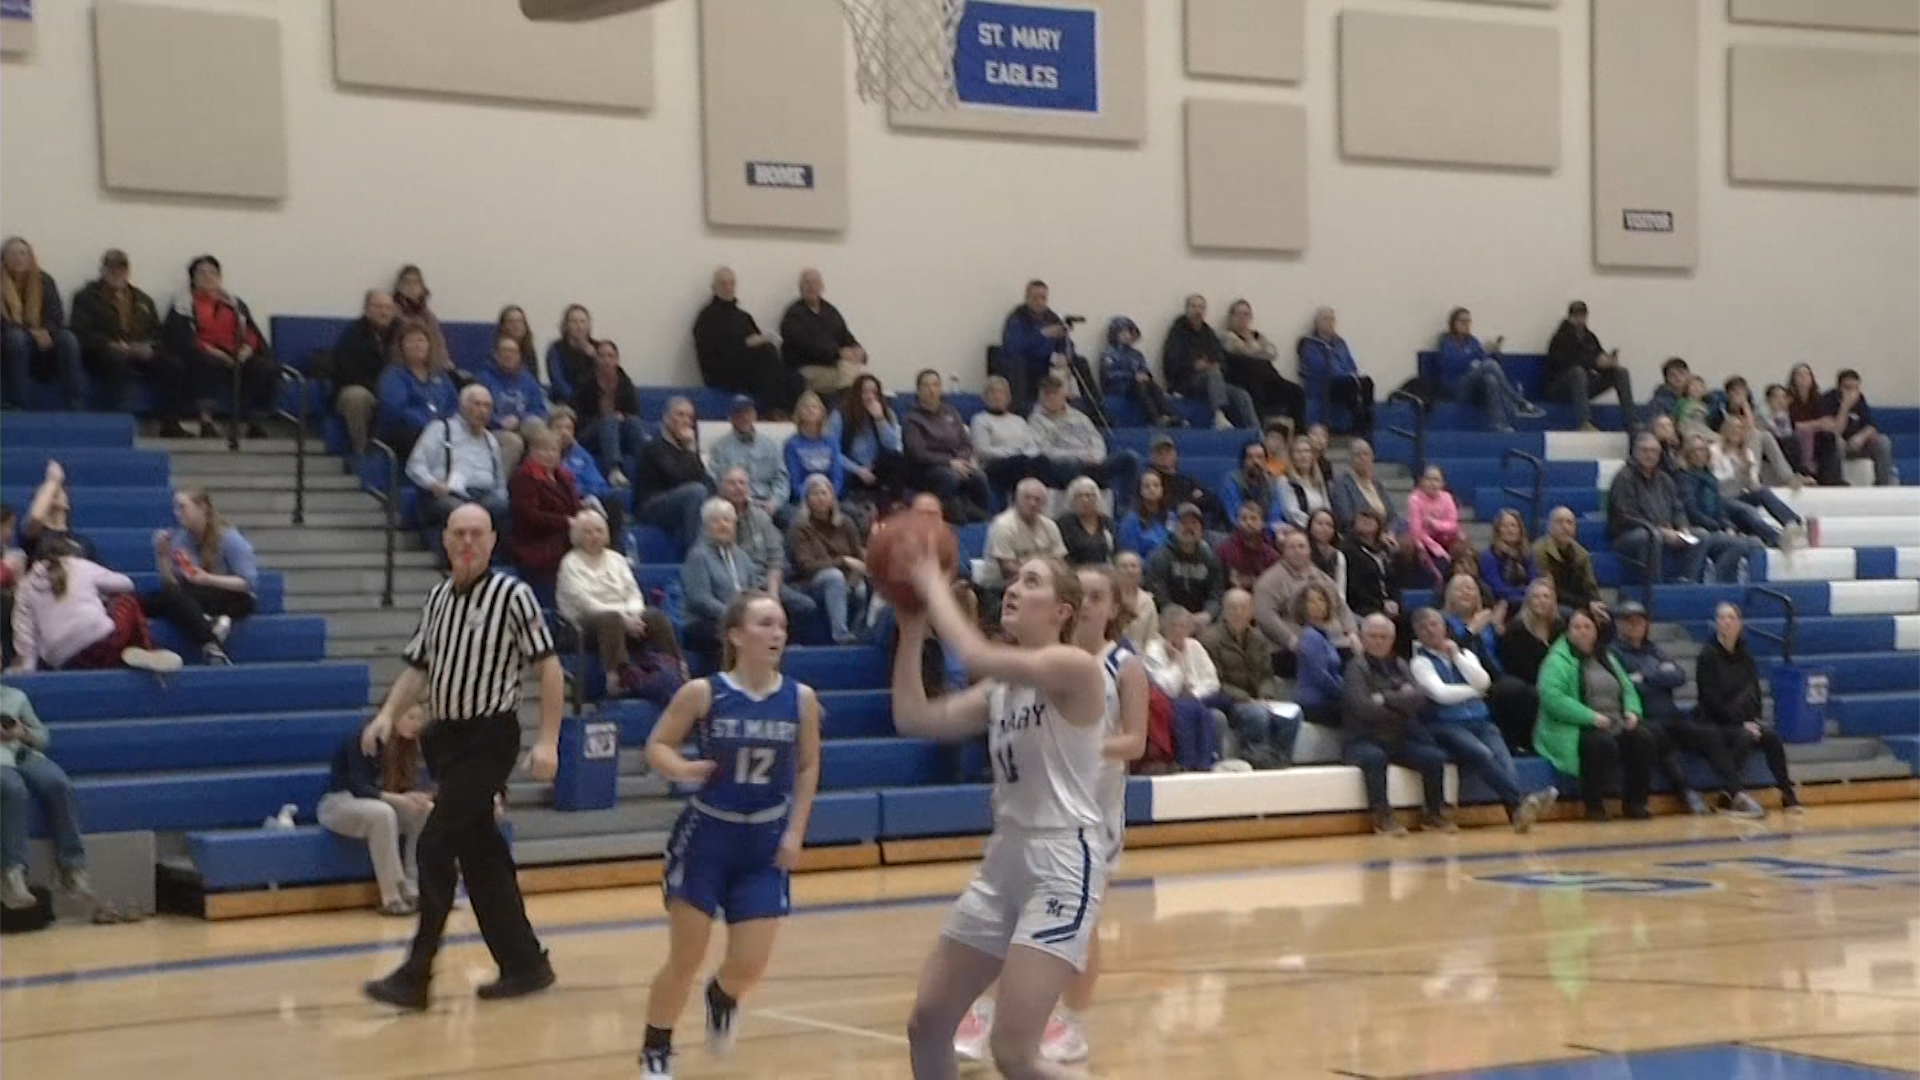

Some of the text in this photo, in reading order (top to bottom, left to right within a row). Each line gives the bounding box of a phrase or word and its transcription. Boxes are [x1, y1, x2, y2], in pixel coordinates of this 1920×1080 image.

[1010, 24, 1062, 51] MARY
[984, 59, 1059, 89] EAGLES
[754, 164, 806, 187] HOME
[734, 747, 777, 784] 12
